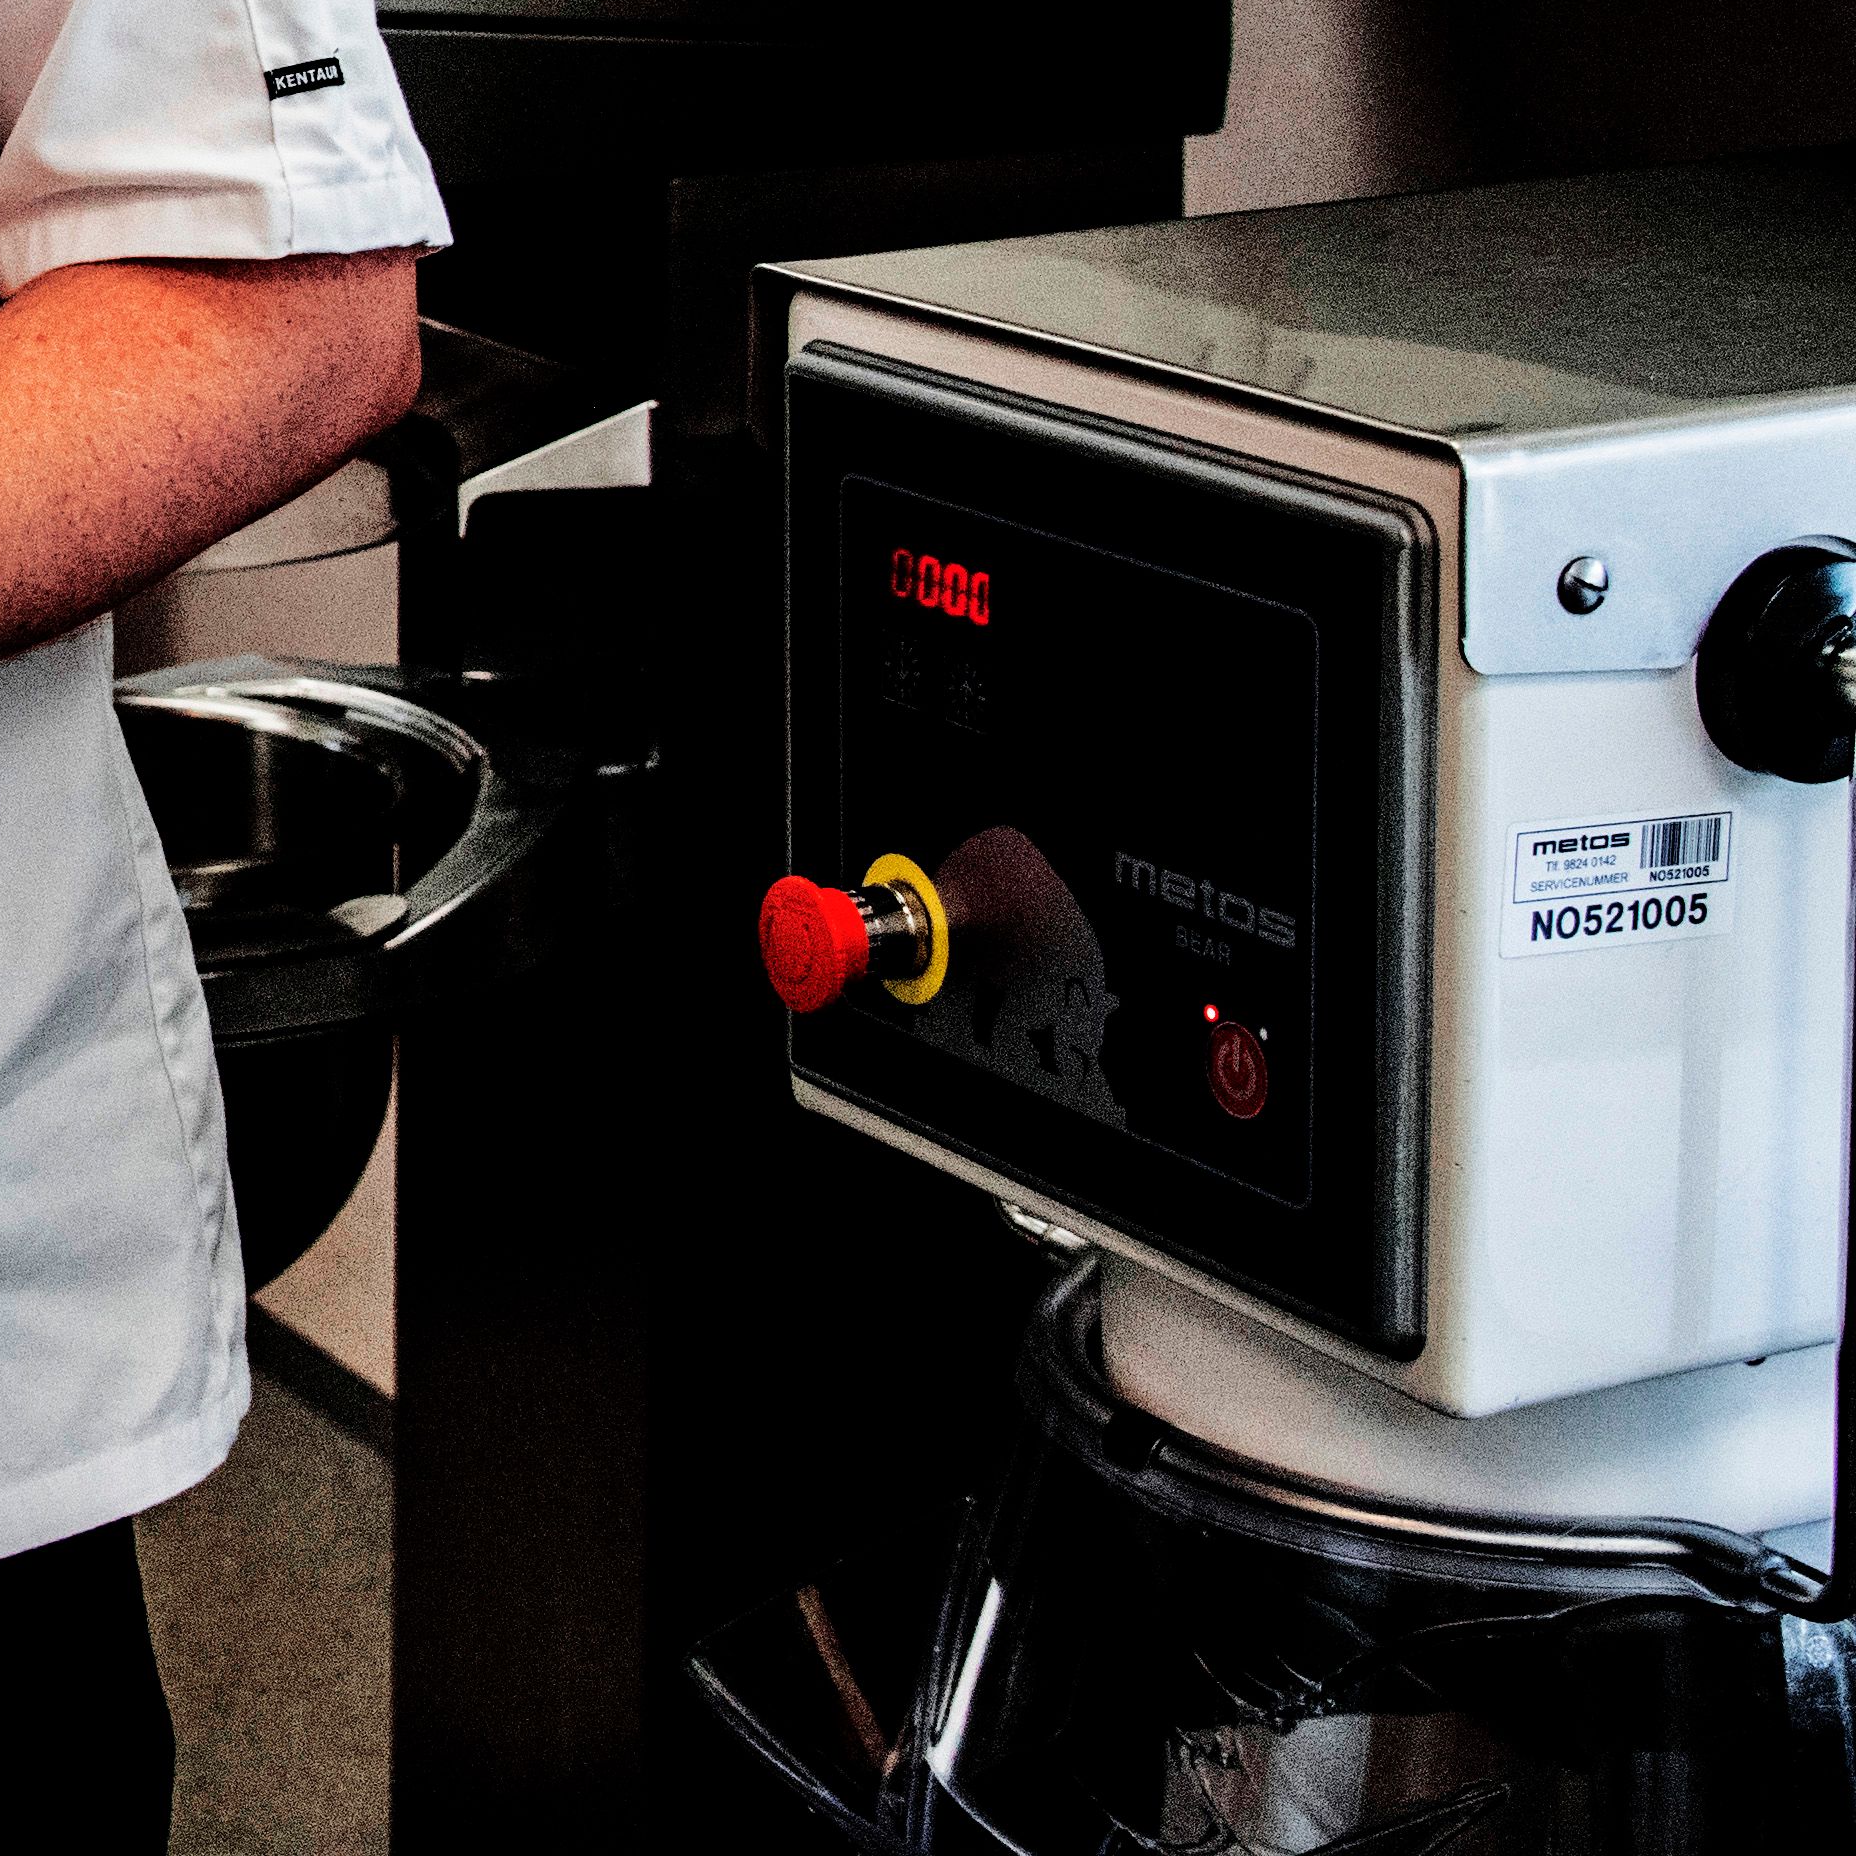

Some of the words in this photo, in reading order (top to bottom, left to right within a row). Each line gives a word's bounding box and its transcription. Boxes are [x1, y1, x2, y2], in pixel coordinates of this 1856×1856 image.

[891, 548, 990, 626] 0000
[1532, 831, 1631, 857] metos
[1545, 860, 1561, 873] Tlf.
[1563, 856, 1589, 872] 9824
[1591, 854, 1618, 870] 0142
[1649, 865, 1710, 882] NO521005
[1530, 872, 1628, 893] SERVICENUMMER
[1115, 850, 1297, 949] metos
[1530, 892, 1709, 942] NO521005
